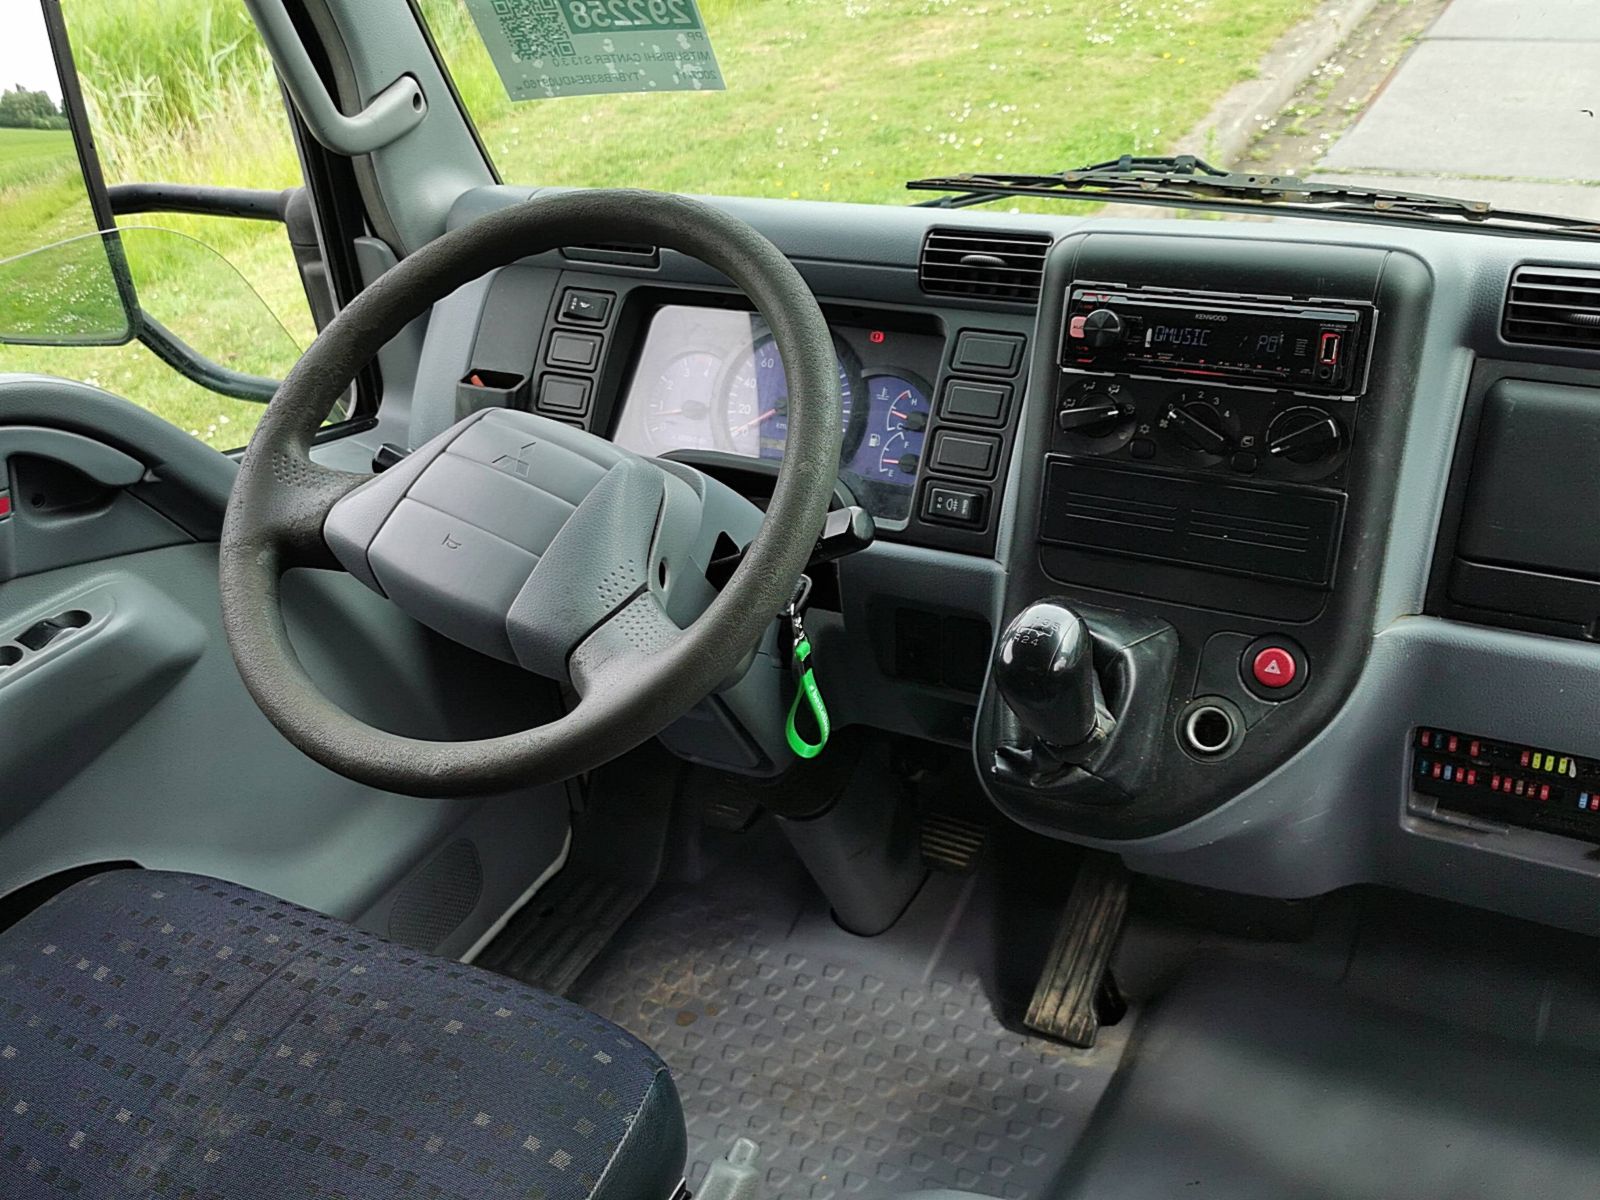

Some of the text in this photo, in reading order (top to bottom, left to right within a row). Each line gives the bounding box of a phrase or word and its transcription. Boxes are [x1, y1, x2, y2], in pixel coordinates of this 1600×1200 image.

[1195, 313, 1228, 322] KENWOOD
[760, 358, 775, 368] 60
[744, 378, 757, 389] 40
[911, 398, 918, 406] H
[1213, 397, 1220, 405] 3
[739, 404, 751, 414] 20
